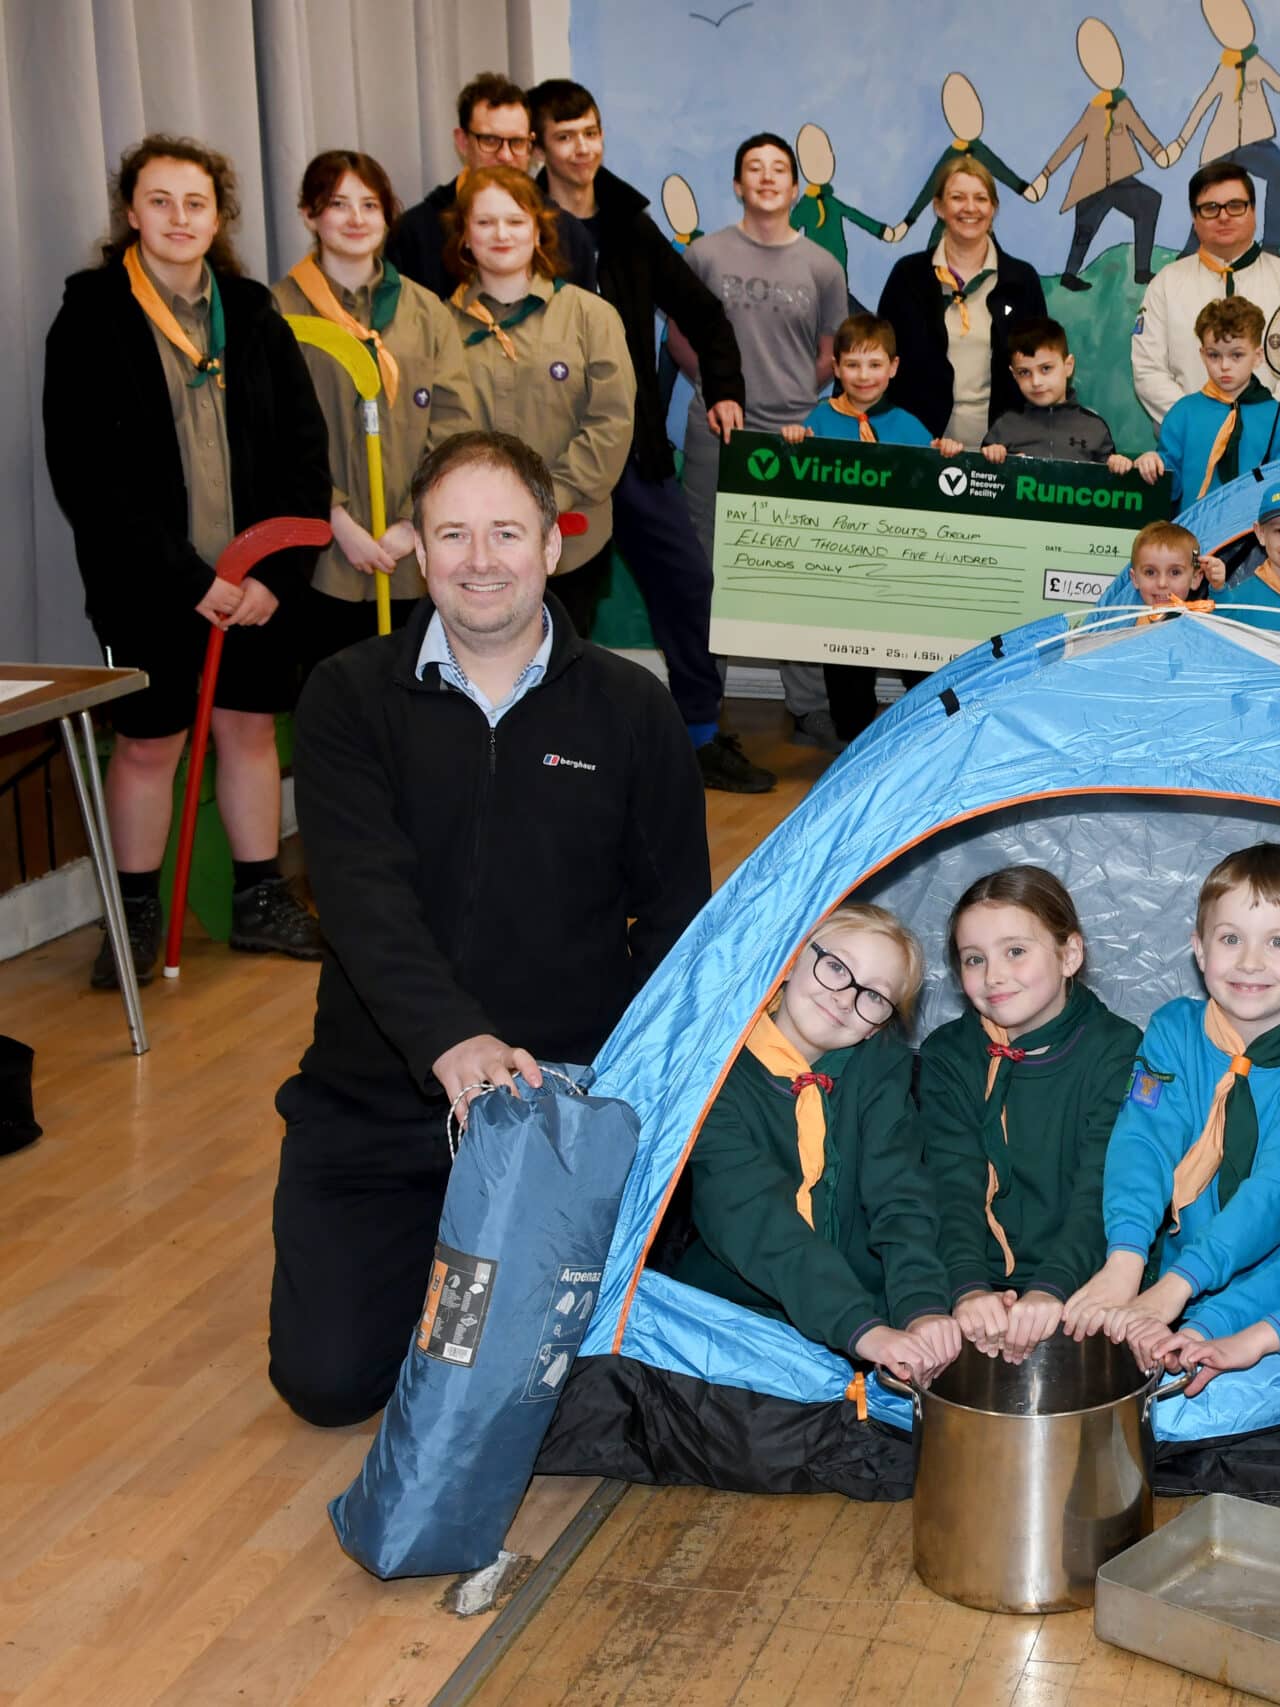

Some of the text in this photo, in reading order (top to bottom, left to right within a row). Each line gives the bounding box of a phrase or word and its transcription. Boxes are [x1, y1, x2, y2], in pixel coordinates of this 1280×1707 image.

[789, 455, 892, 488] Viridor
[970, 470, 997, 481] Energy
[969, 489, 997, 499] Facility
[970, 480, 1005, 491] Recovery
[1016, 475, 1143, 511] Runcorn
[727, 509, 748, 520] PAY
[772, 507, 820, 528] WSTON
[734, 529, 801, 549] ELEVEN
[902, 549, 929, 561] FIVE
[1045, 543, 1119, 558] DATE 2024
[734, 552, 843, 574] POUNDS ONLY
[560, 756, 596, 771] berghaus
[561, 1267, 602, 1285] Arpenaz
